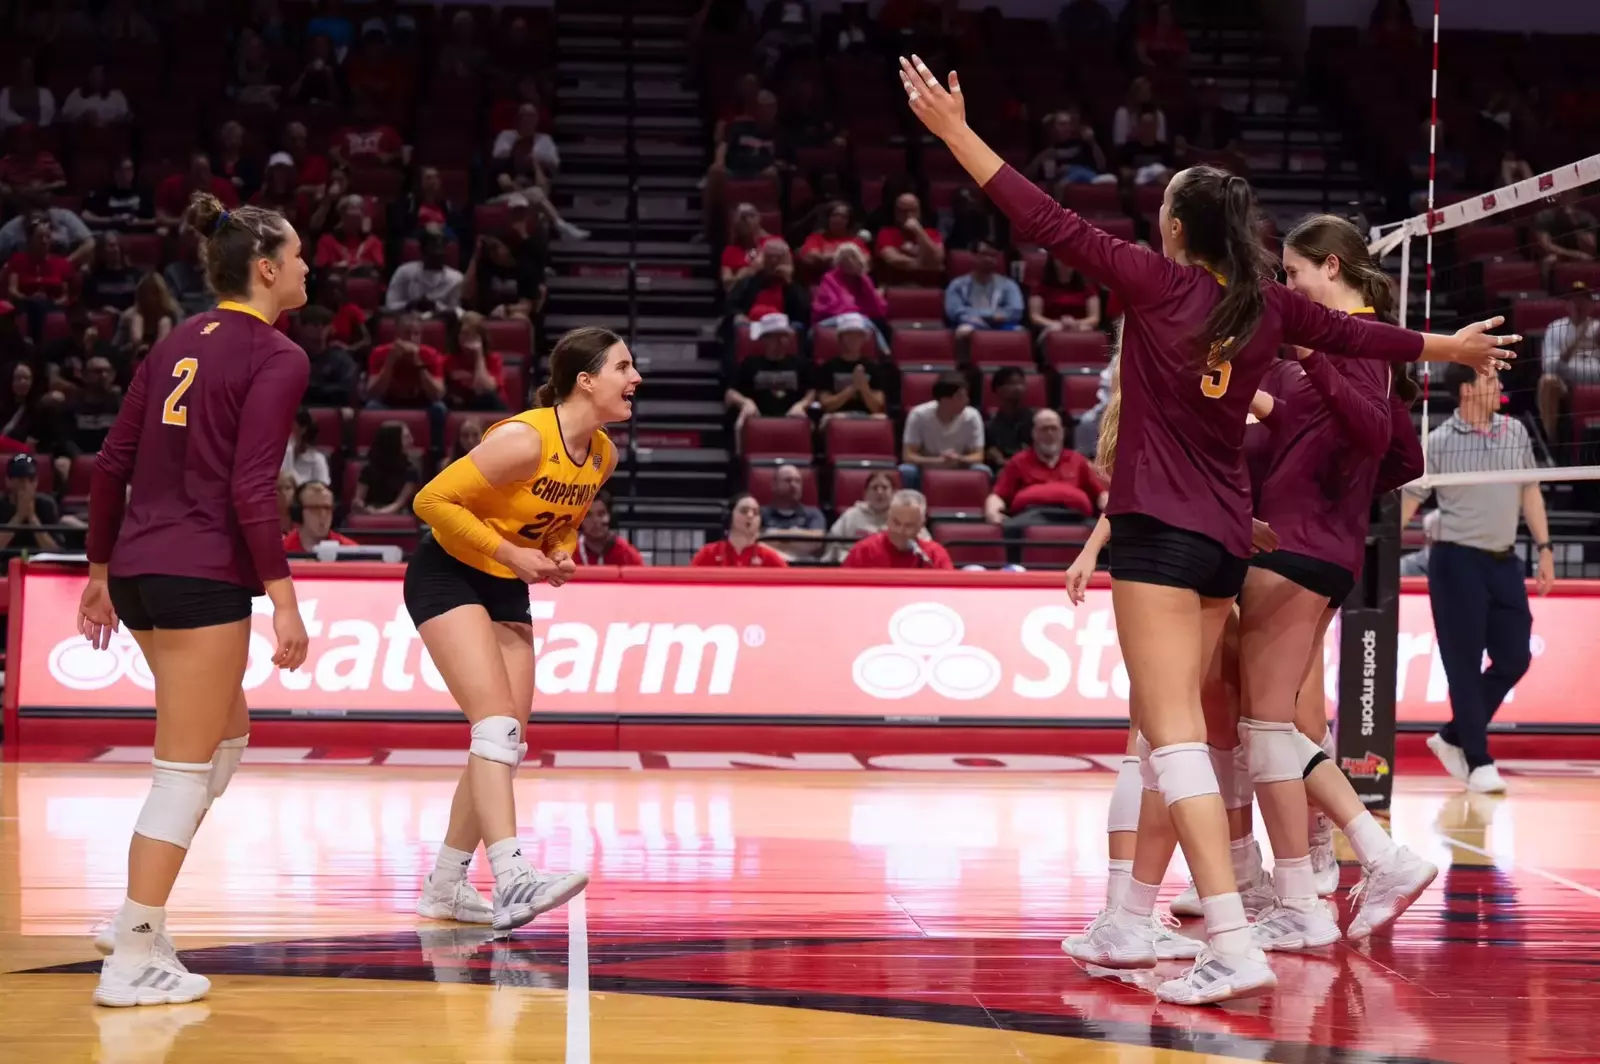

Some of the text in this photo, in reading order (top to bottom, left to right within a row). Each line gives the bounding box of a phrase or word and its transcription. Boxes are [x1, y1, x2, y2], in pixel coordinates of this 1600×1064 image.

[162, 357, 198, 426] 2
[1360, 630, 1377, 736] sports imports
